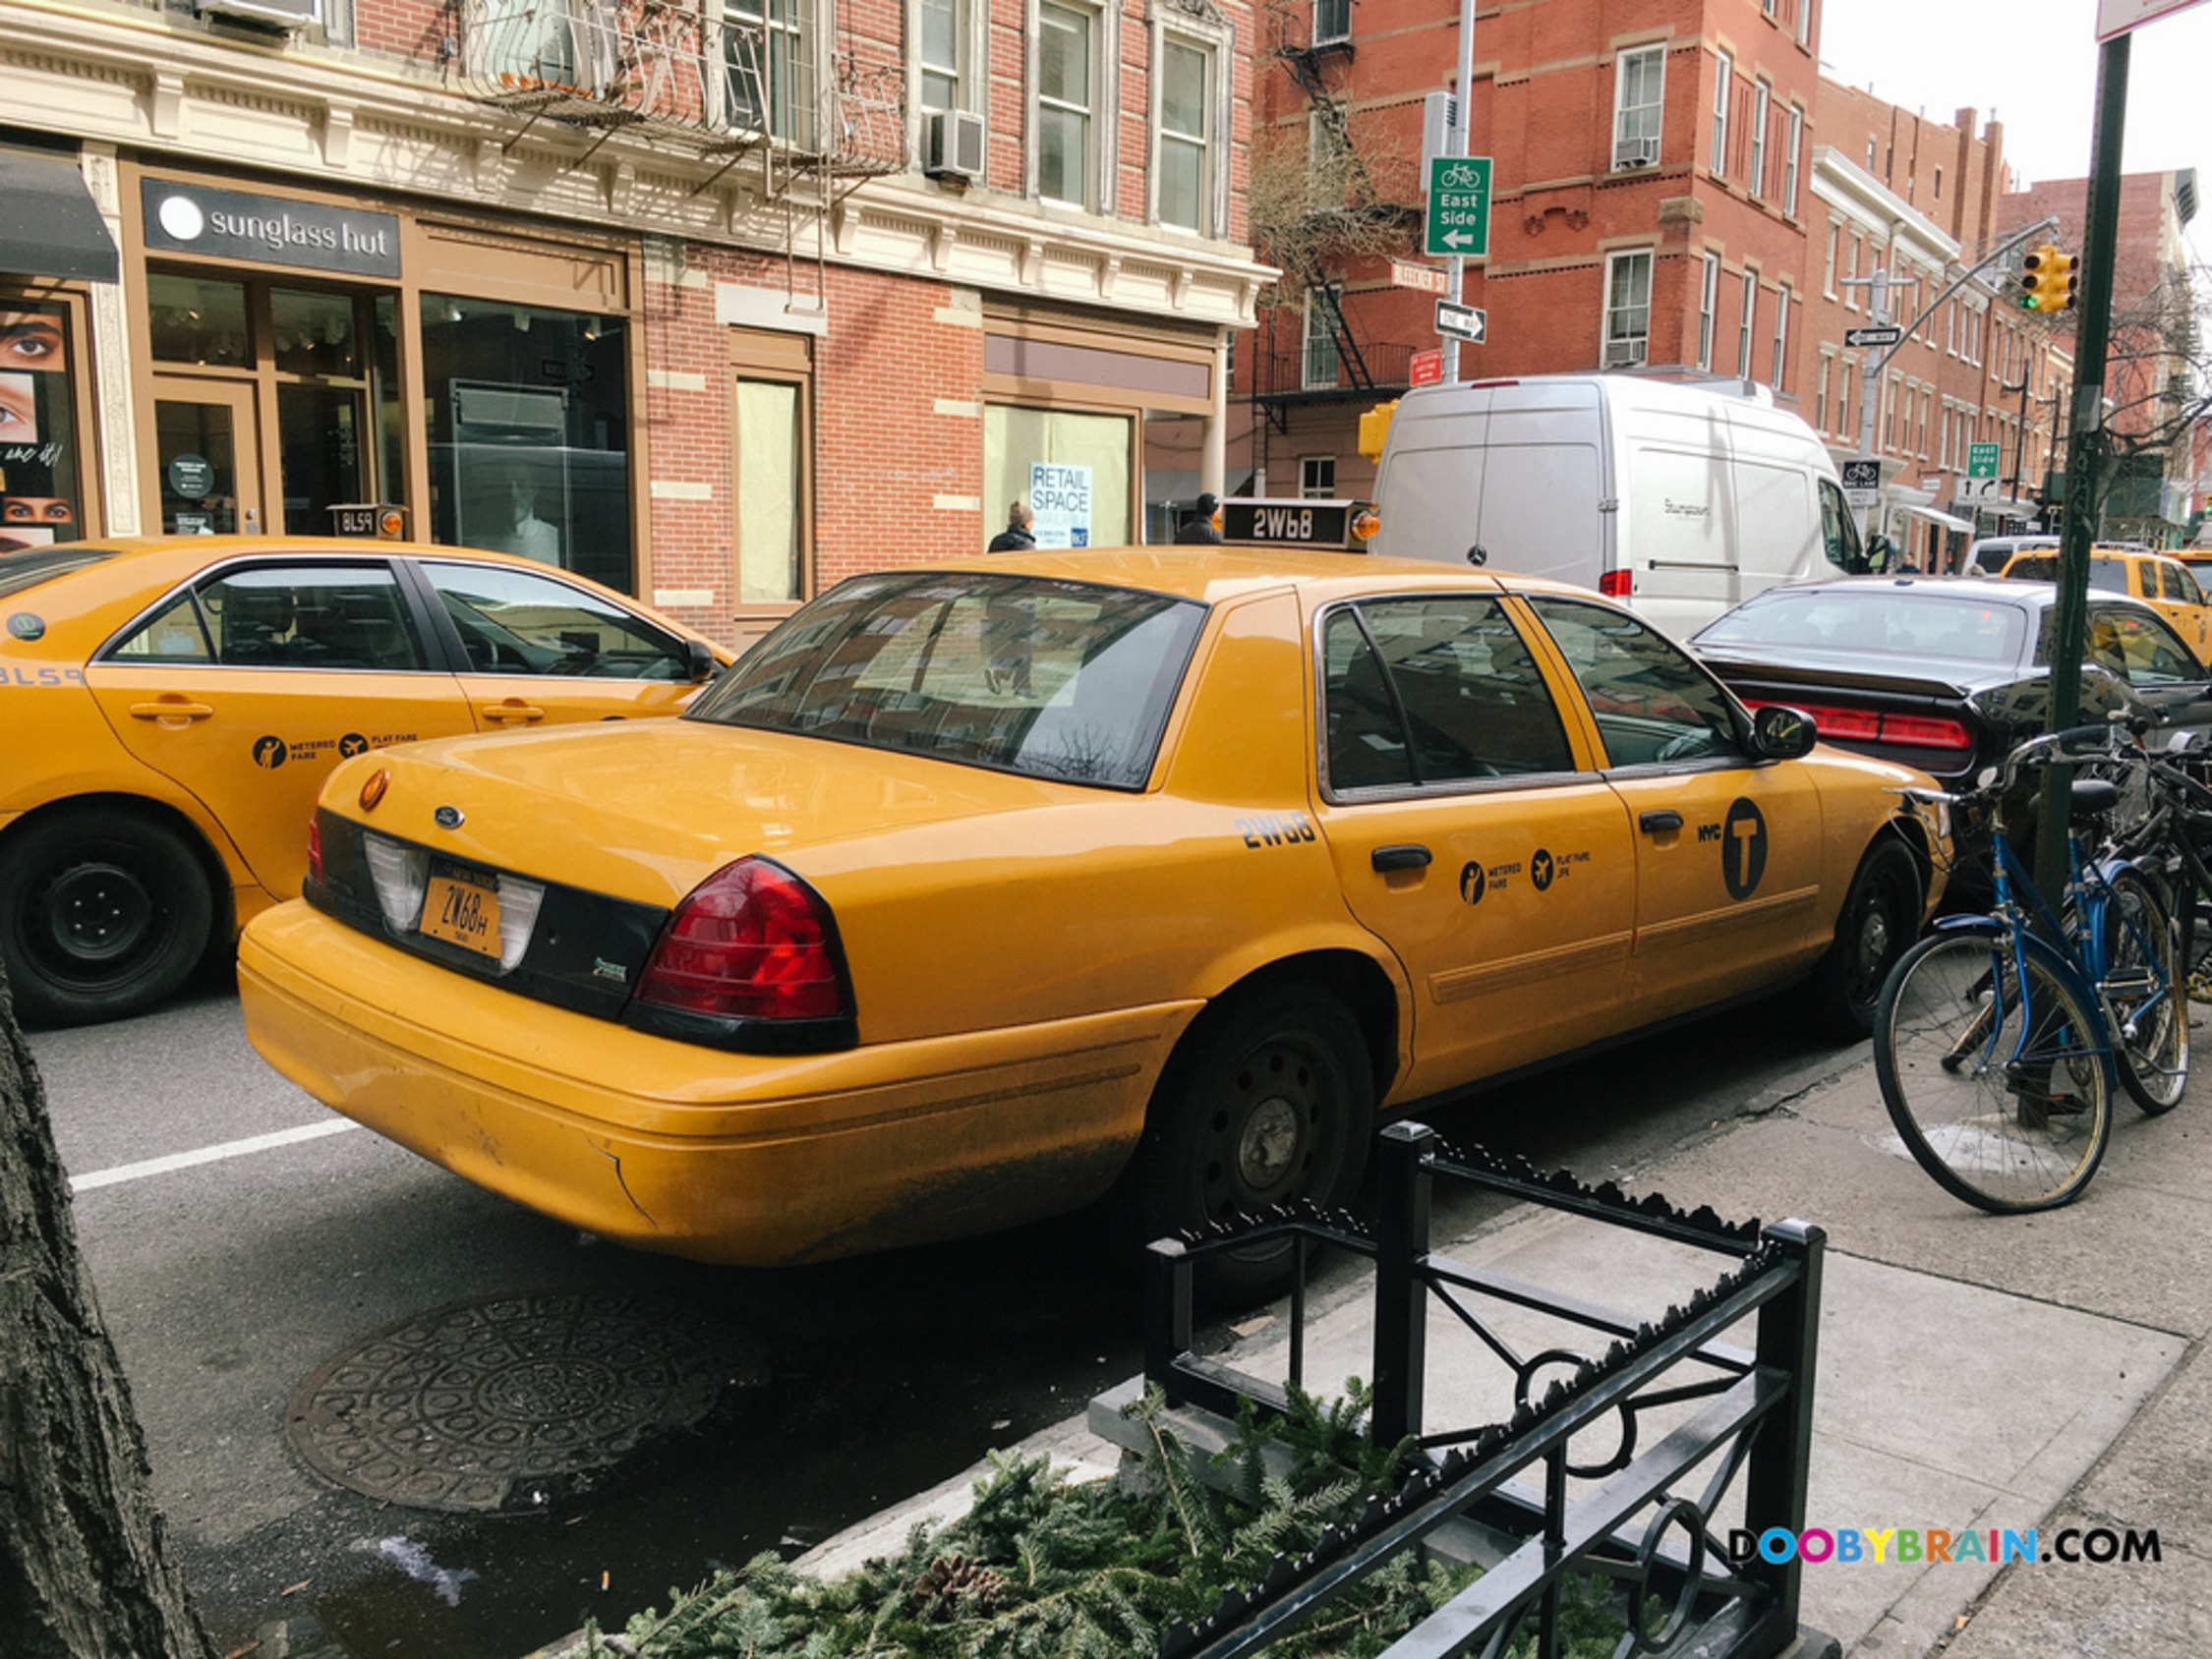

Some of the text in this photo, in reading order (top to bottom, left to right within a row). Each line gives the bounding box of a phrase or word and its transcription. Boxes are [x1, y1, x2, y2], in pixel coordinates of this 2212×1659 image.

[1440, 194, 1478, 207] East
[1440, 211, 1477, 226] Side
[210, 210, 387, 256] sunglass hut
[1435, 271, 1446, 294] ST
[1441, 311, 1482, 330] ONE WAY
[1972, 446, 1997, 455] East
[1972, 455, 1996, 464] Side
[1032, 466, 1088, 490] RETAIL
[1032, 489, 1088, 513] SPACE
[342, 512, 374, 532] 8L59
[395, 733, 418, 742] FARE
[290, 740, 335, 750] METERED
[291, 751, 317, 762] FARE
[1697, 823, 1721, 843] NYC
[1488, 863, 1521, 877] METERED
[1489, 879, 1507, 889] FARE
